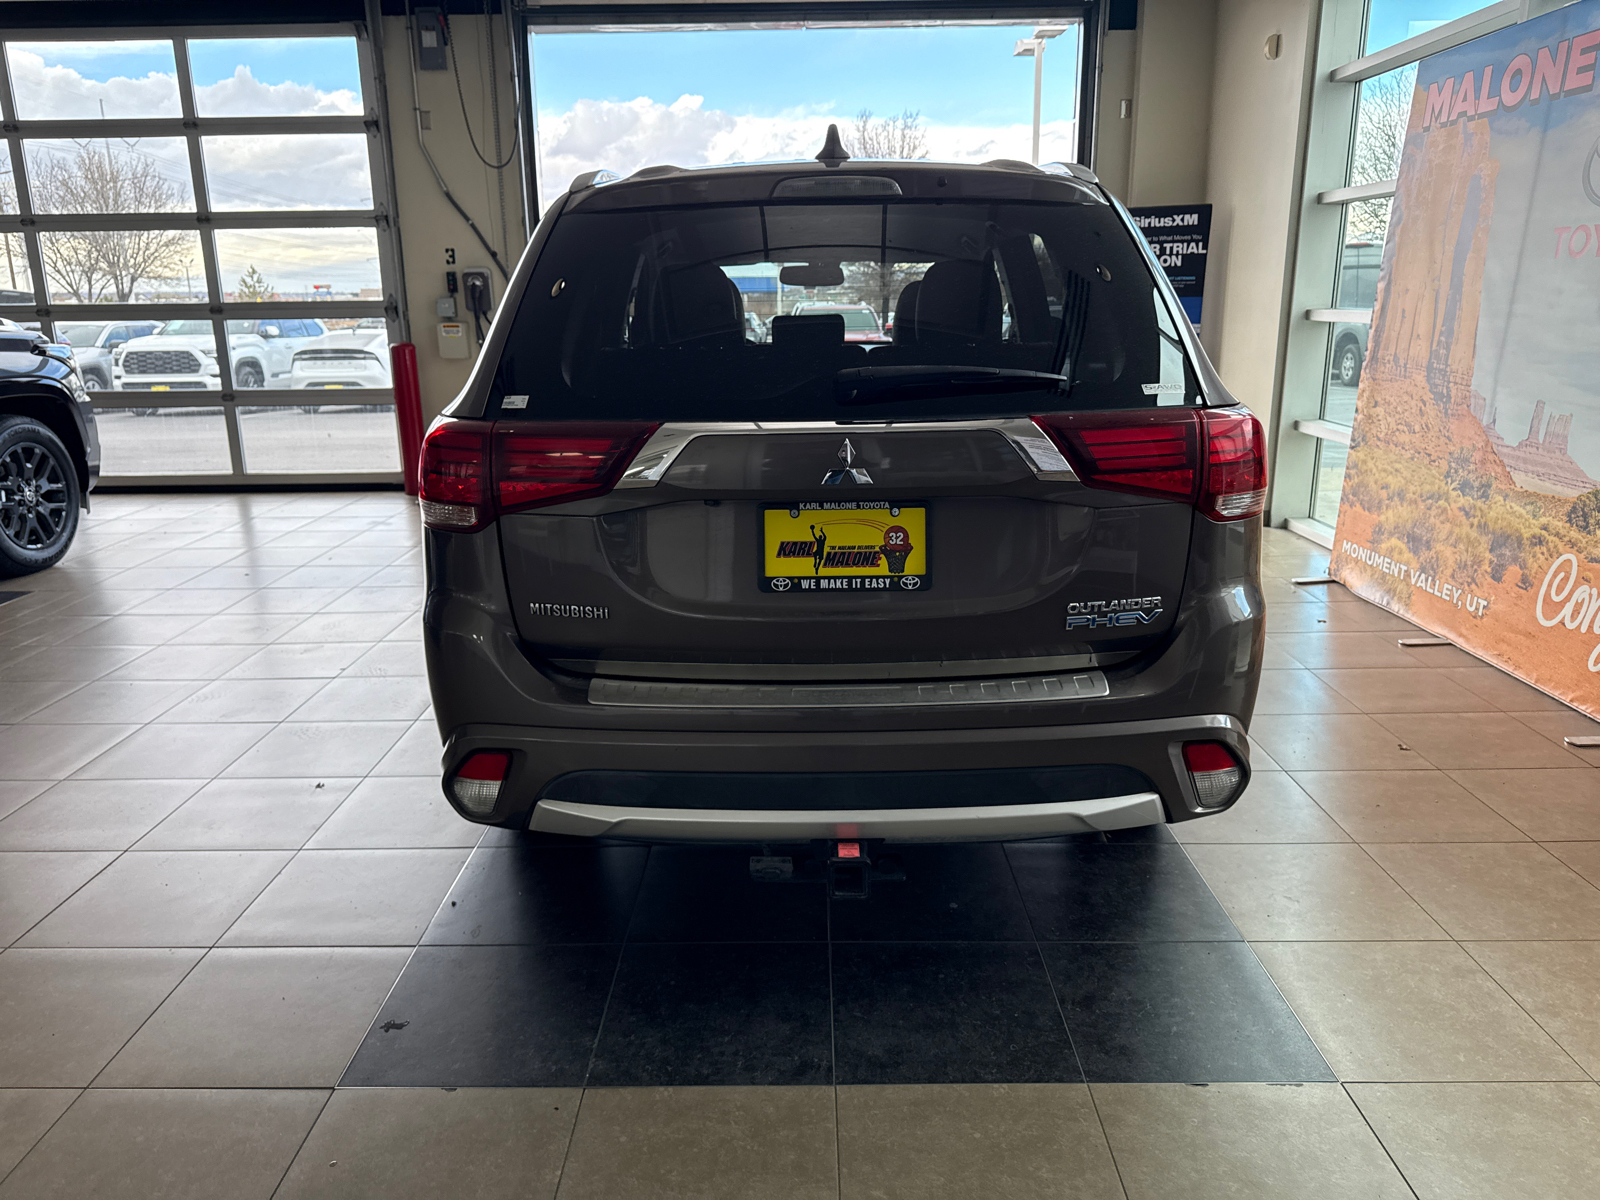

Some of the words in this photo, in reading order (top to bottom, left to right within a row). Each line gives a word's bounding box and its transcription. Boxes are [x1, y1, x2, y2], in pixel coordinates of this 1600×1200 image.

[1422, 30, 1600, 131] MALONE
[1133, 213, 1199, 228] SiriusXM
[1163, 241, 1207, 255] TRIAL
[1554, 223, 1600, 259] TO
[445, 248, 456, 265] 3
[799, 502, 822, 510] KARL
[823, 502, 857, 510] MALONE
[858, 501, 890, 509] TOYOTA
[889, 532, 904, 544] 32
[776, 541, 816, 558] KARL
[822, 551, 881, 568] MALONE
[801, 578, 816, 589] WE
[820, 578, 848, 589] MAKE
[852, 578, 861, 588] IT
[865, 578, 891, 588] EASY
[1341, 539, 1409, 580] MONUMENT
[1410, 570, 1463, 610] VALLEY,
[1466, 593, 1489, 617] UT
[529, 602, 609, 619] MITSUBISHI
[1067, 596, 1162, 614] OUTLANDER
[1065, 608, 1164, 630] PHEV
